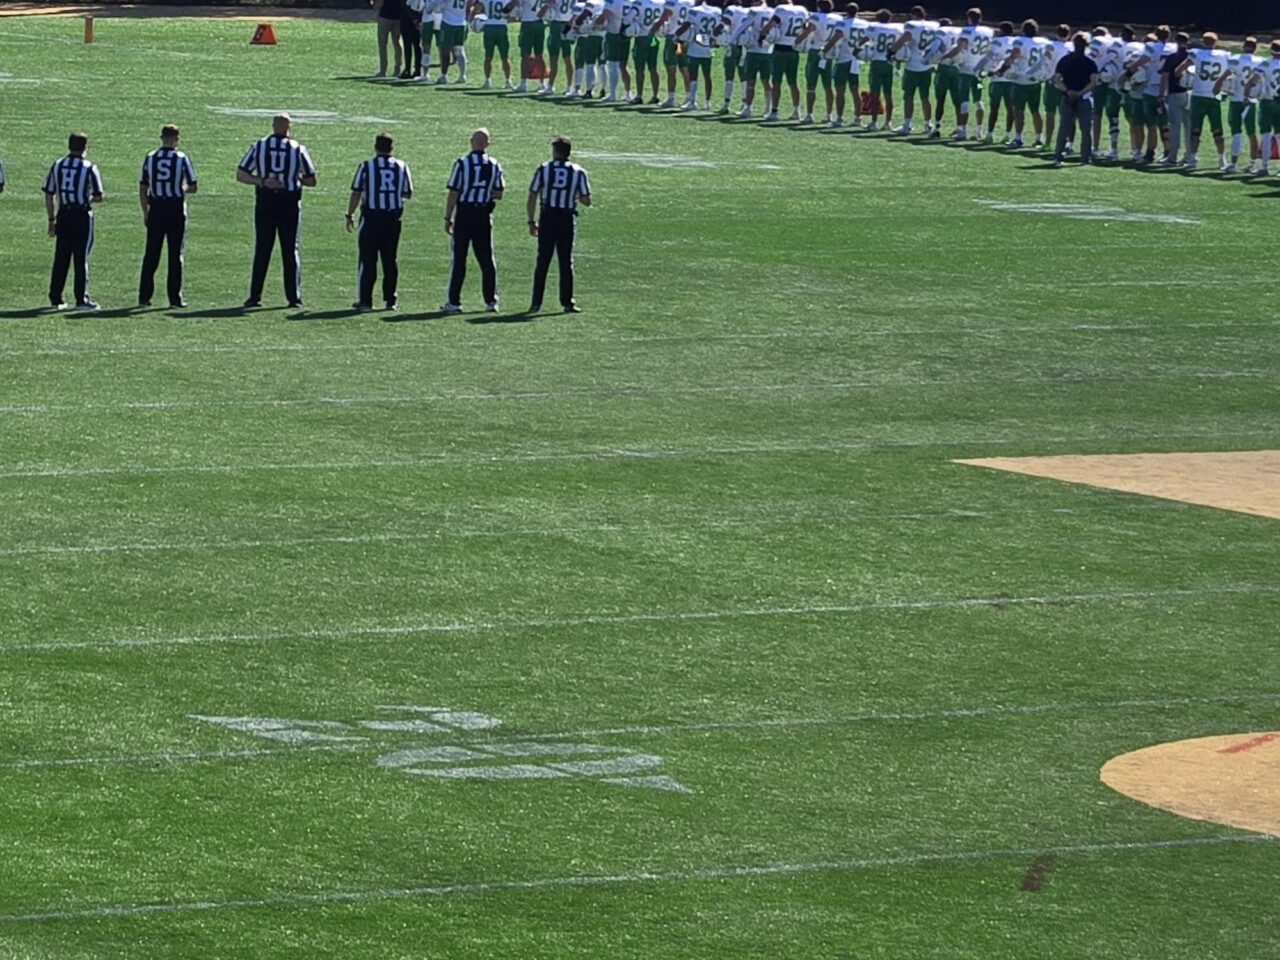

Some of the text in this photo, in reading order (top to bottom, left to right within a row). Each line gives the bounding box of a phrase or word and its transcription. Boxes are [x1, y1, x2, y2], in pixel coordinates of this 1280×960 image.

[1199, 60, 1222, 81] 52
[156, 158, 172, 180] S
[271, 151, 286, 172] U
[380, 169, 396, 191] R
[473, 165, 487, 187] L
[552, 167, 569, 188] B
